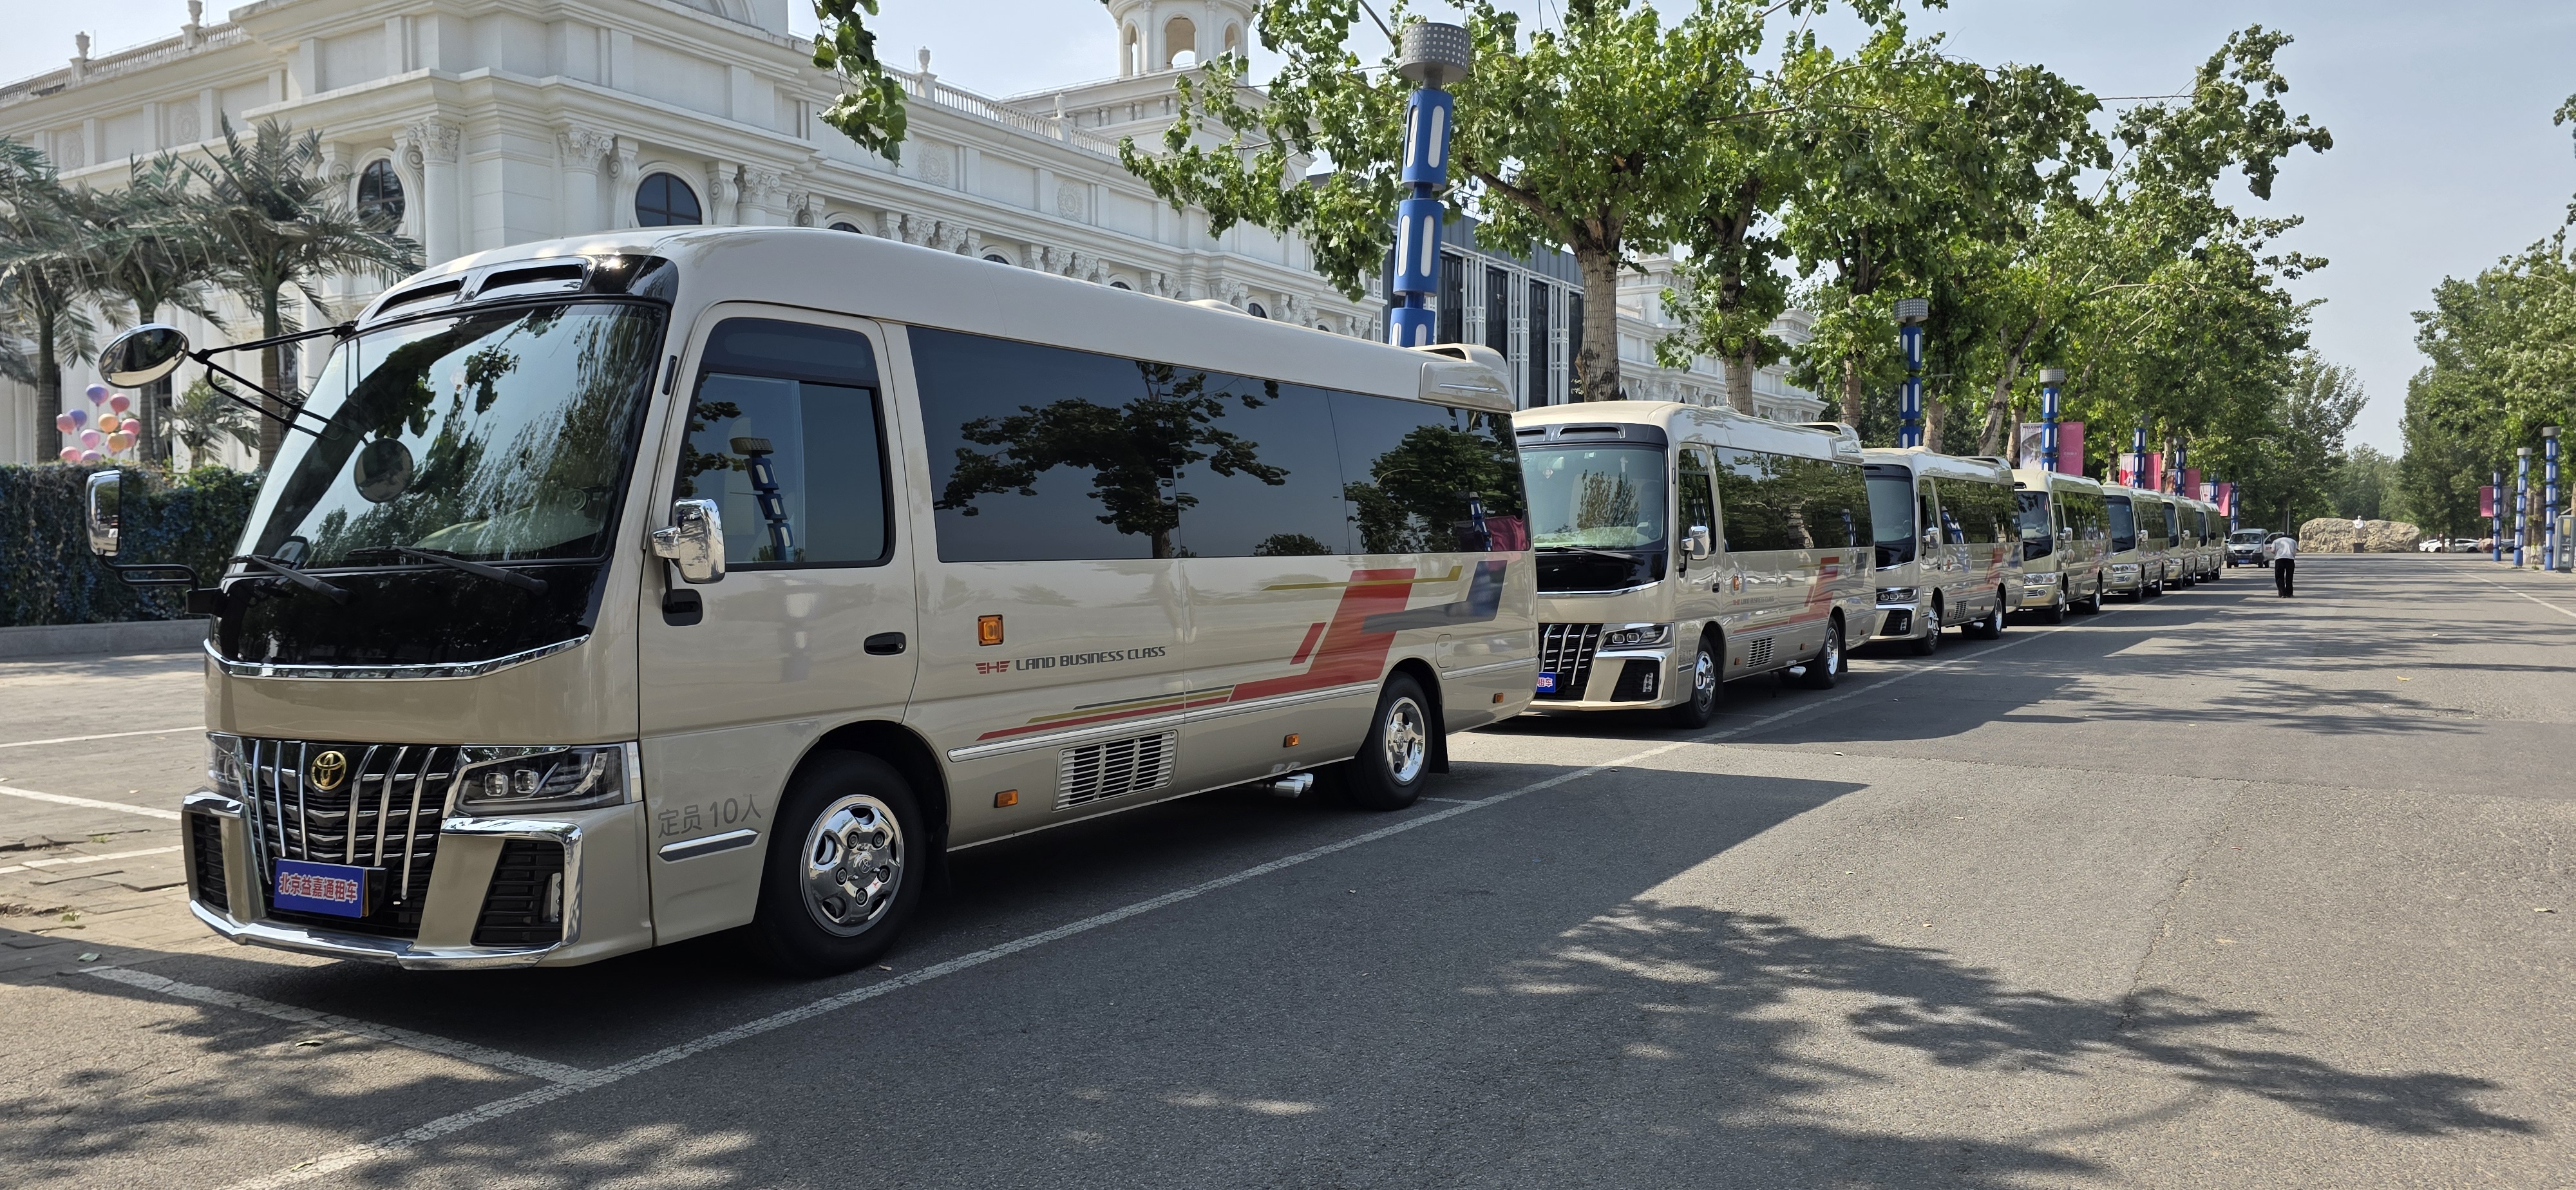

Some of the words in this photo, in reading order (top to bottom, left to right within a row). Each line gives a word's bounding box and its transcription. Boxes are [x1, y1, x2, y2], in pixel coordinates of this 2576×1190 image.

[1016, 656, 1056, 671] LAND
[1059, 650, 1124, 666] BUSINESS
[1127, 646, 1166, 660] CLASS
[278, 871, 358, 903] 北京益嘉通租车
